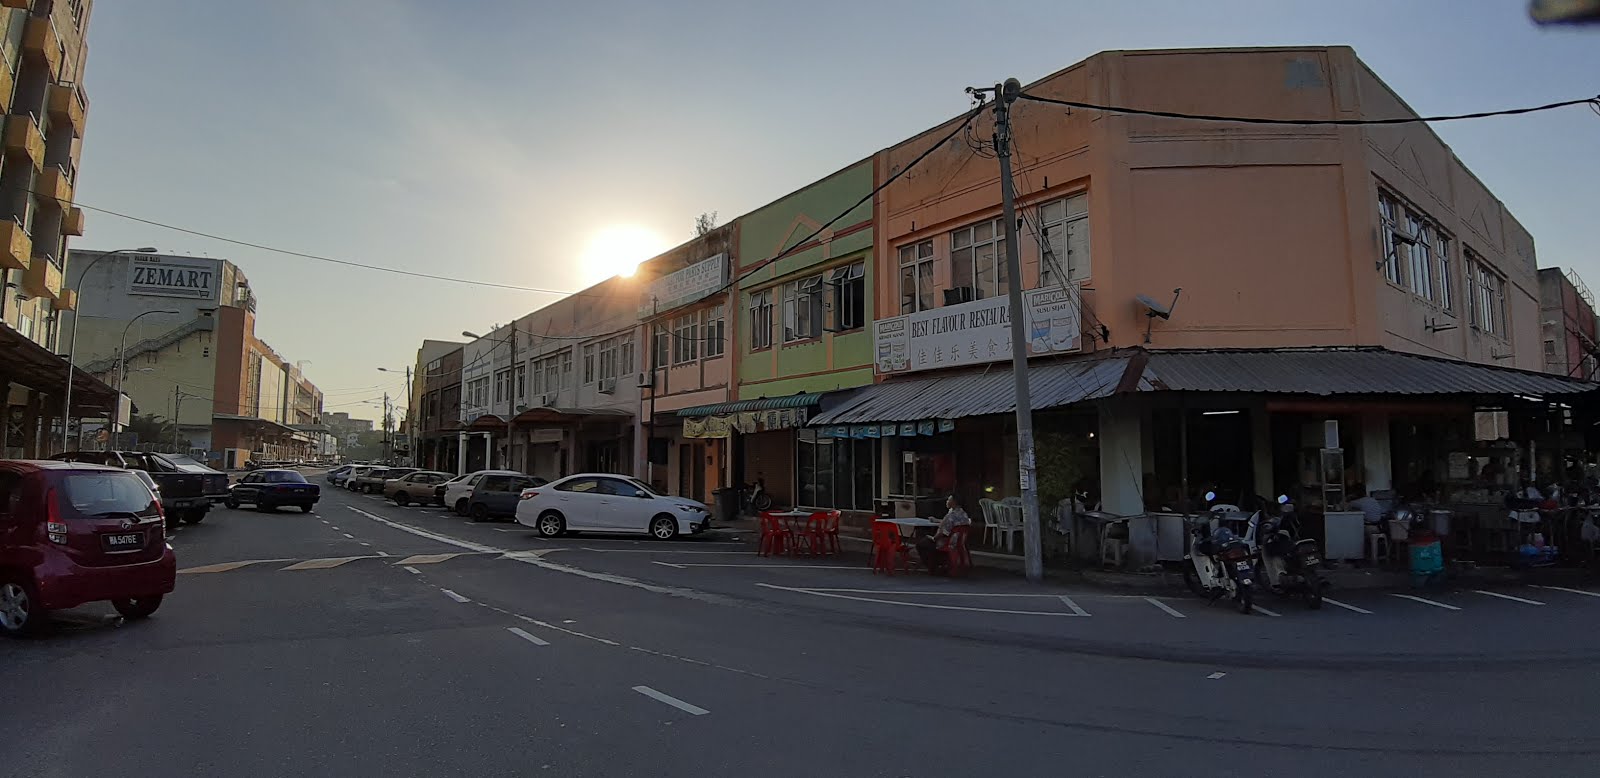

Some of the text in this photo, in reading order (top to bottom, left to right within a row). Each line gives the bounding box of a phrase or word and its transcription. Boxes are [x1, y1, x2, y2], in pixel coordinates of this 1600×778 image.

[133, 267, 212, 288] ZEMART
[1033, 289, 1069, 306] MARIGOL
[1036, 304, 1066, 314] SUSU SEJAT
[912, 320, 929, 339] BEST
[932, 314, 966, 334] FLAVOUR
[969, 305, 1011, 328] RESTAURA
